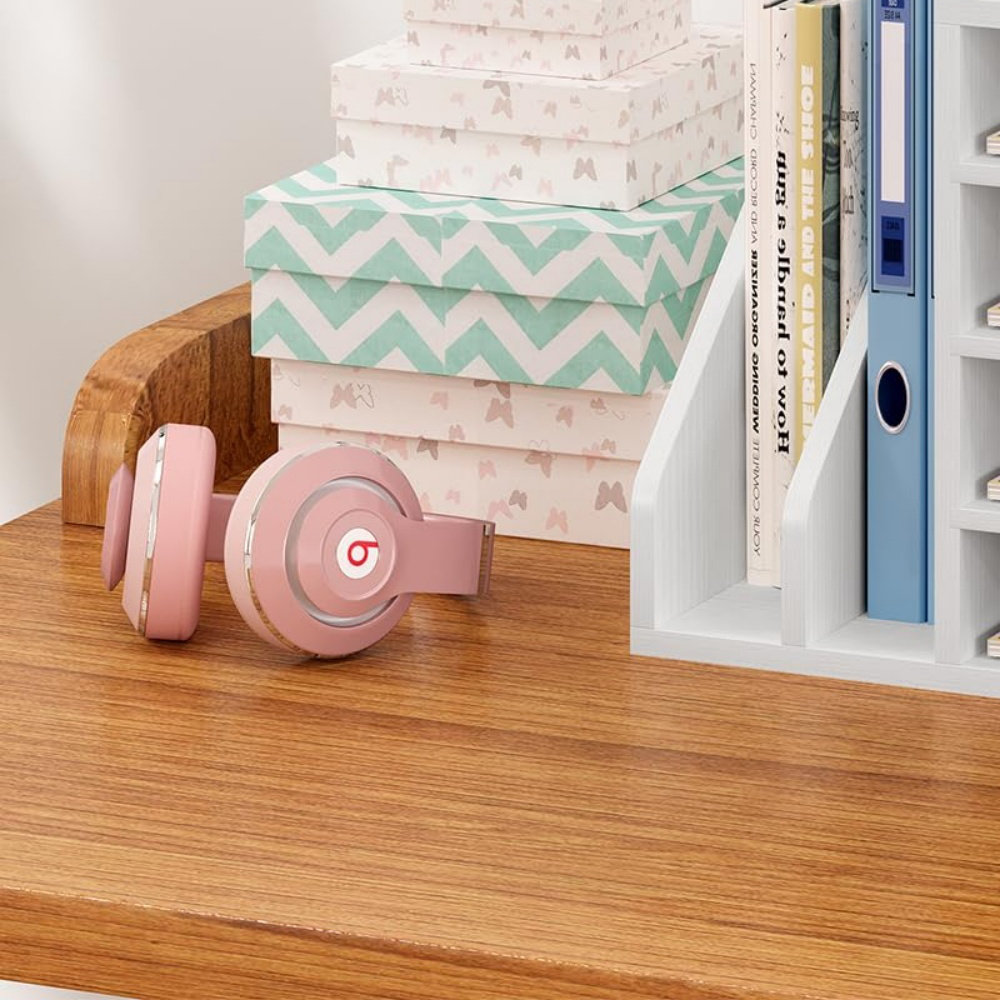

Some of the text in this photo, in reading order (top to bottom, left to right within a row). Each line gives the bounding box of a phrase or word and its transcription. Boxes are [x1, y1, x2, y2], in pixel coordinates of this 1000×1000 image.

[800, 64, 814, 160] SHOE
[801, 168, 815, 221] THE
[801, 225, 815, 277] AND
